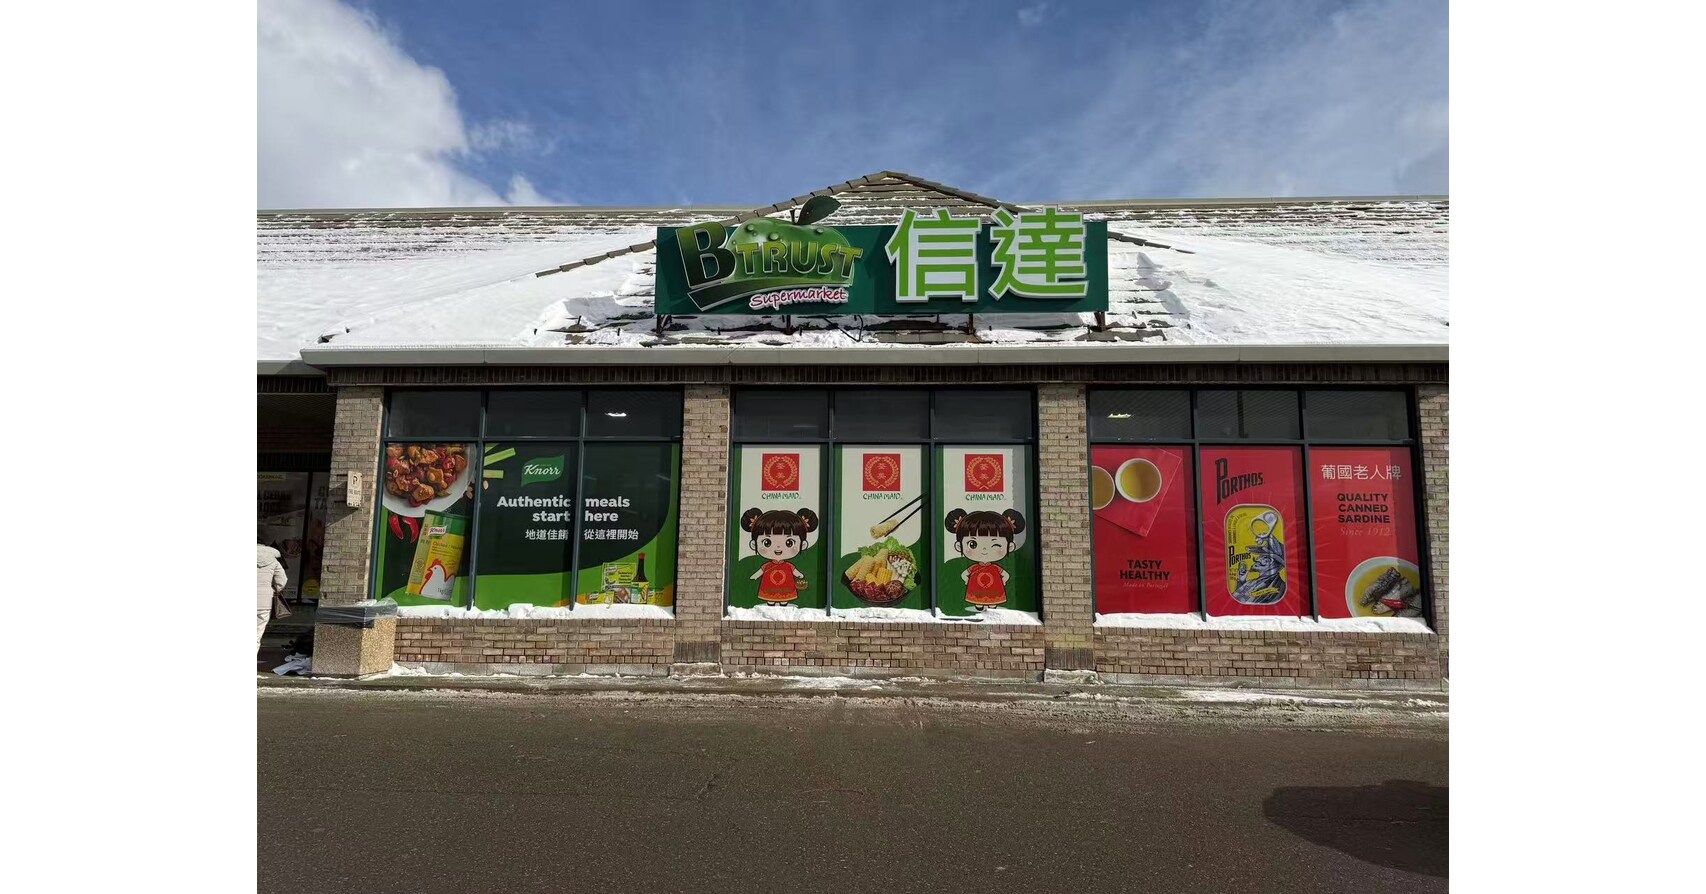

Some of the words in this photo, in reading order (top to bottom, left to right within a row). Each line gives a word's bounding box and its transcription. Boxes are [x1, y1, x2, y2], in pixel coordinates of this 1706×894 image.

[886, 206, 1090, 302] 信達
[749, 286, 848, 310] Supermarket
[523, 464, 561, 475] Knorr
[1321, 464, 1401, 480] 葡國老人牌
[496, 494, 571, 508] Authentic
[585, 496, 630, 508] meals
[1337, 493, 1388, 502] QUALITY
[1338, 504, 1389, 513] CANNED
[532, 510, 571, 522] start
[584, 510, 619, 522] here
[1338, 514, 1391, 524] SARDINE
[583, 529, 640, 541] 從這裡開始
[1340, 526, 1363, 536] Since
[1368, 527, 1392, 537] 1912
[1127, 559, 1162, 570] TASTY
[1119, 569, 1170, 581] HEALTHY
